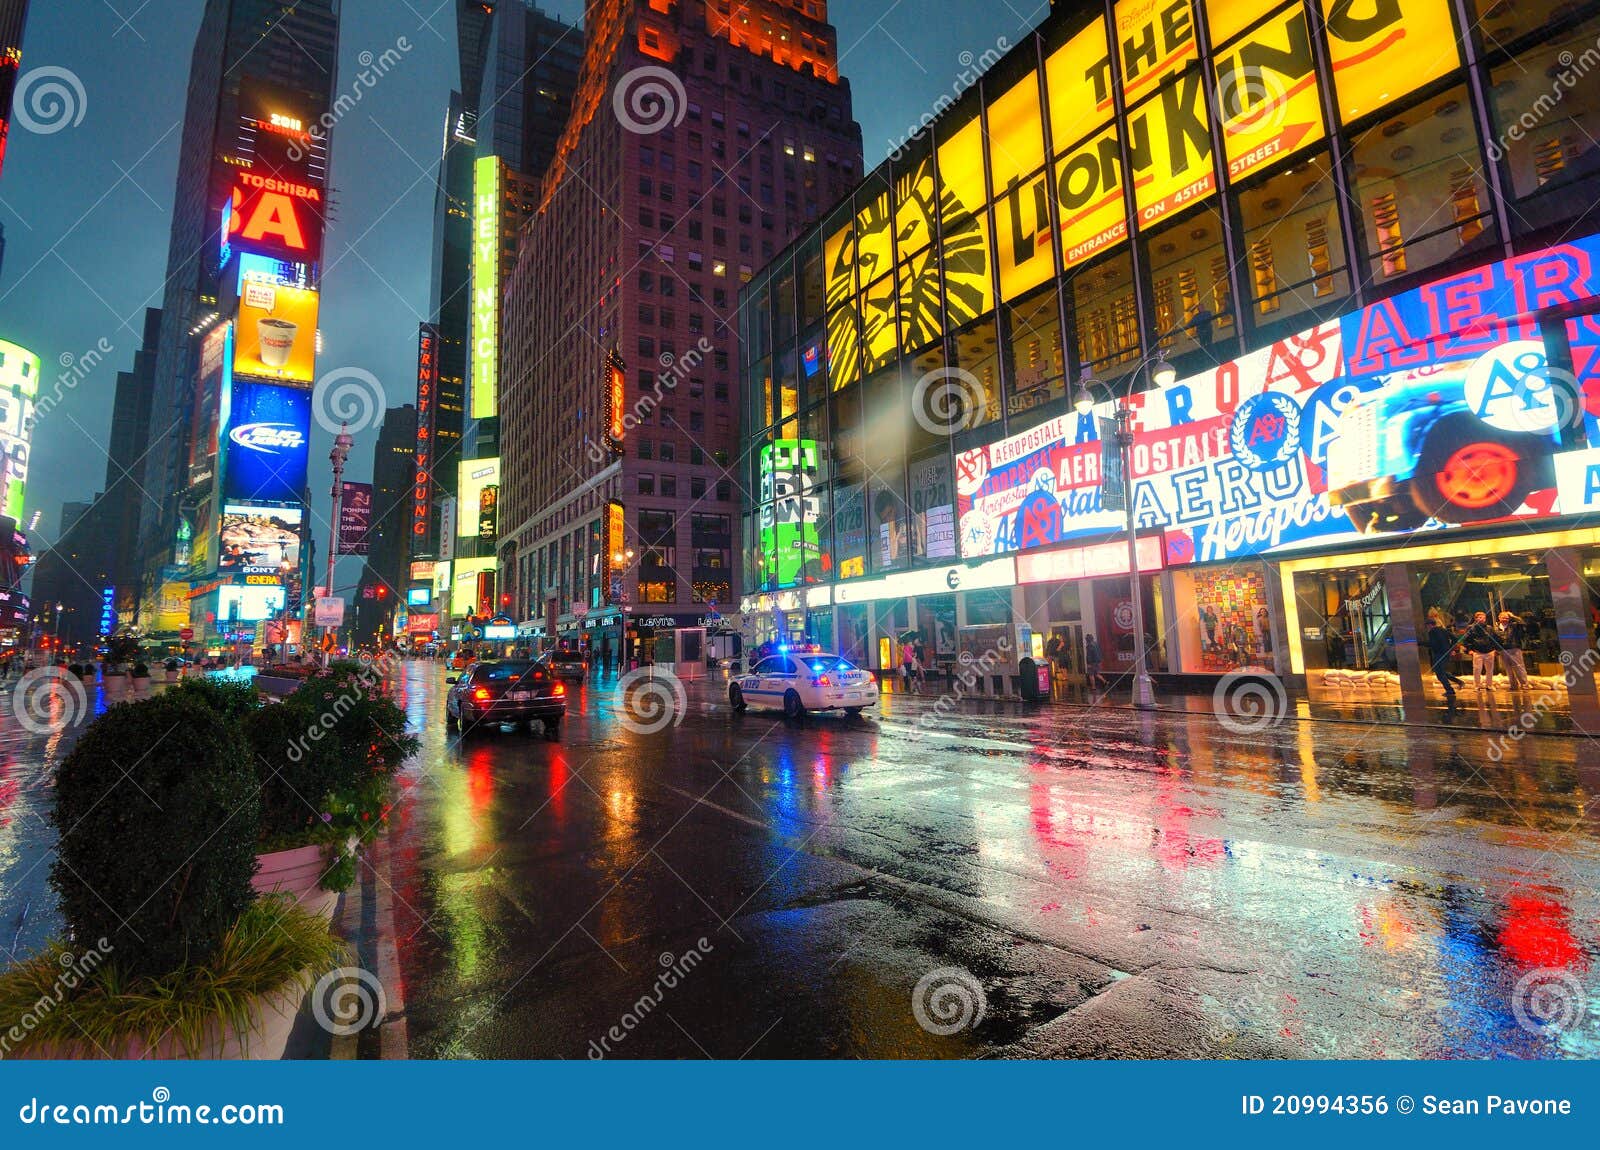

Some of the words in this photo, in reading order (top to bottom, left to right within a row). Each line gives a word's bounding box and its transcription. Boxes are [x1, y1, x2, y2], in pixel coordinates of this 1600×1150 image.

[1084, 0, 1194, 105] THE
[239, 172, 320, 201] TOSHIBA
[1007, 111, 1153, 266] LION
[1067, 222, 1127, 261] ENTRANCE
[1144, 200, 1166, 220] ON
[1173, 178, 1210, 205] 45TH
[1230, 140, 1282, 176] STREET
[478, 193, 494, 263] HEY
[418, 337, 431, 412] ERNST
[417, 427, 429, 439] &
[414, 453, 428, 535] YOUNG
[242, 566, 278, 574] SONY
